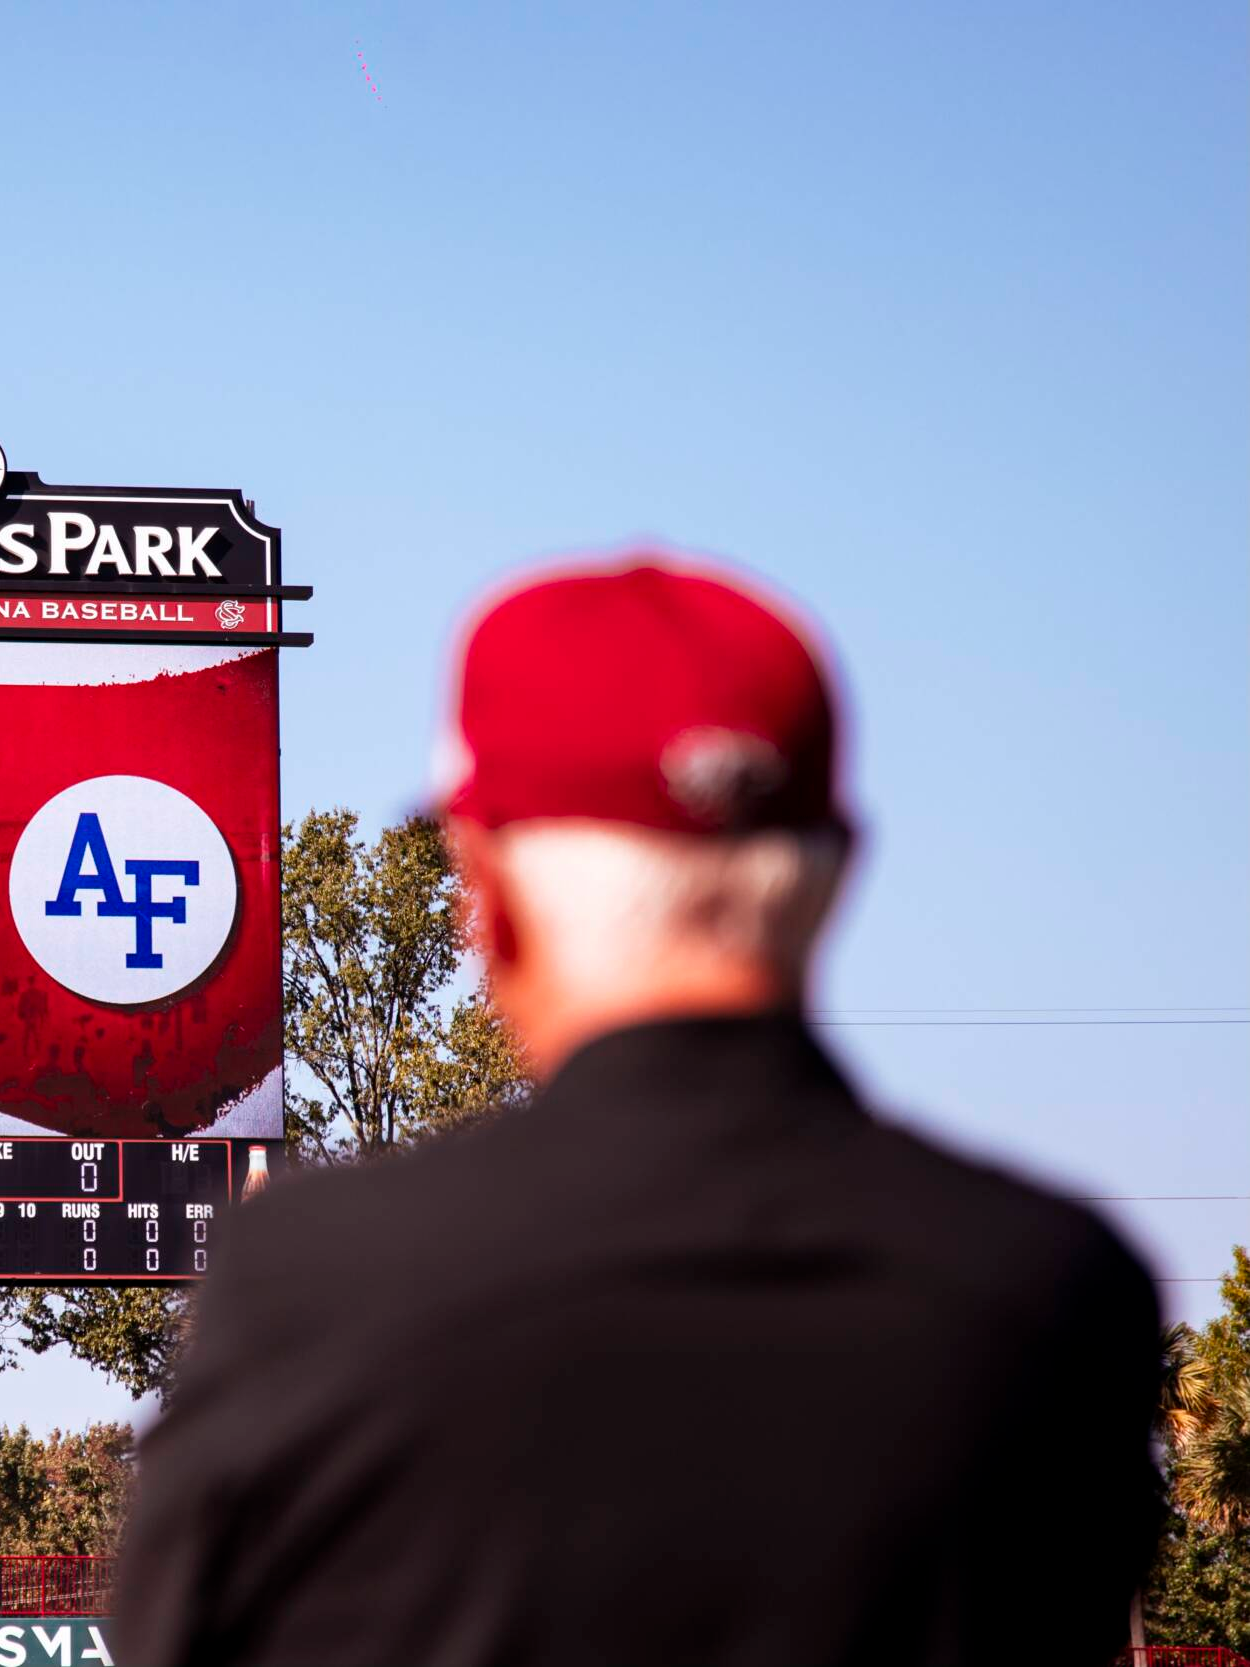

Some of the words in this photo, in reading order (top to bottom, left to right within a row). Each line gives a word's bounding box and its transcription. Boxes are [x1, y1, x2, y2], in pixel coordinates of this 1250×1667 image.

[47, 511, 224, 578] PARK
[41, 601, 194, 622] BASEBALL
[71, 1142, 105, 1161] OUT
[171, 1143, 200, 1163] H/E
[80, 1162, 98, 1192] 0
[17, 1202, 37, 1218] 10
[61, 1202, 101, 1219] RUNS
[127, 1203, 159, 1219] HITS
[185, 1203, 213, 1219] ERR
[83, 1219, 96, 1242] 0
[145, 1219, 159, 1243] 0
[193, 1220, 207, 1243] 0
[83, 1248, 97, 1271] 0
[146, 1248, 159, 1272] 0
[194, 1249, 207, 1272] 0
